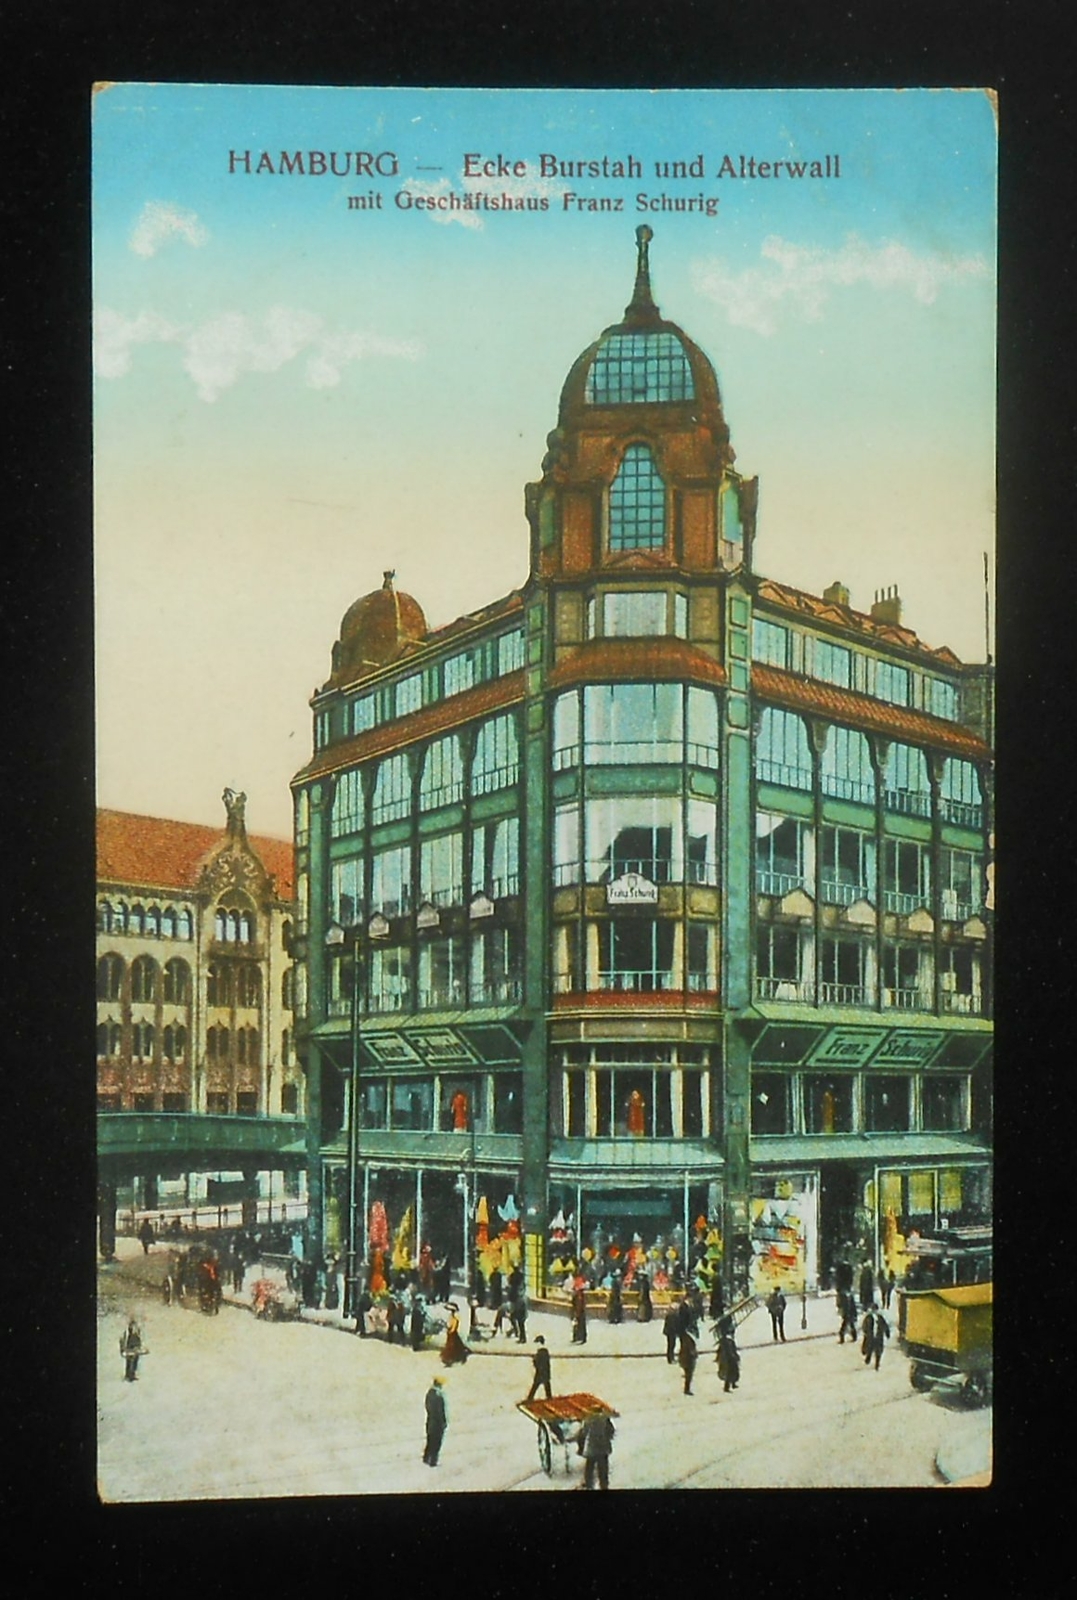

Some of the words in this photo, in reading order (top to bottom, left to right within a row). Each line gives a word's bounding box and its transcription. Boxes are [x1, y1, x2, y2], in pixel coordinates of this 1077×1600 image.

[228, 149, 399, 178] HAMBURG
[463, 152, 526, 178] Ecke
[538, 153, 643, 179] Burstah
[654, 154, 705, 179] und
[716, 154, 841, 179] Alterwall
[347, 190, 383, 210] mit
[394, 190, 550, 211] Geschäftshaus
[562, 192, 624, 212] Franz
[635, 192, 719, 217] Schurig
[824, 1037, 870, 1056] Franz
